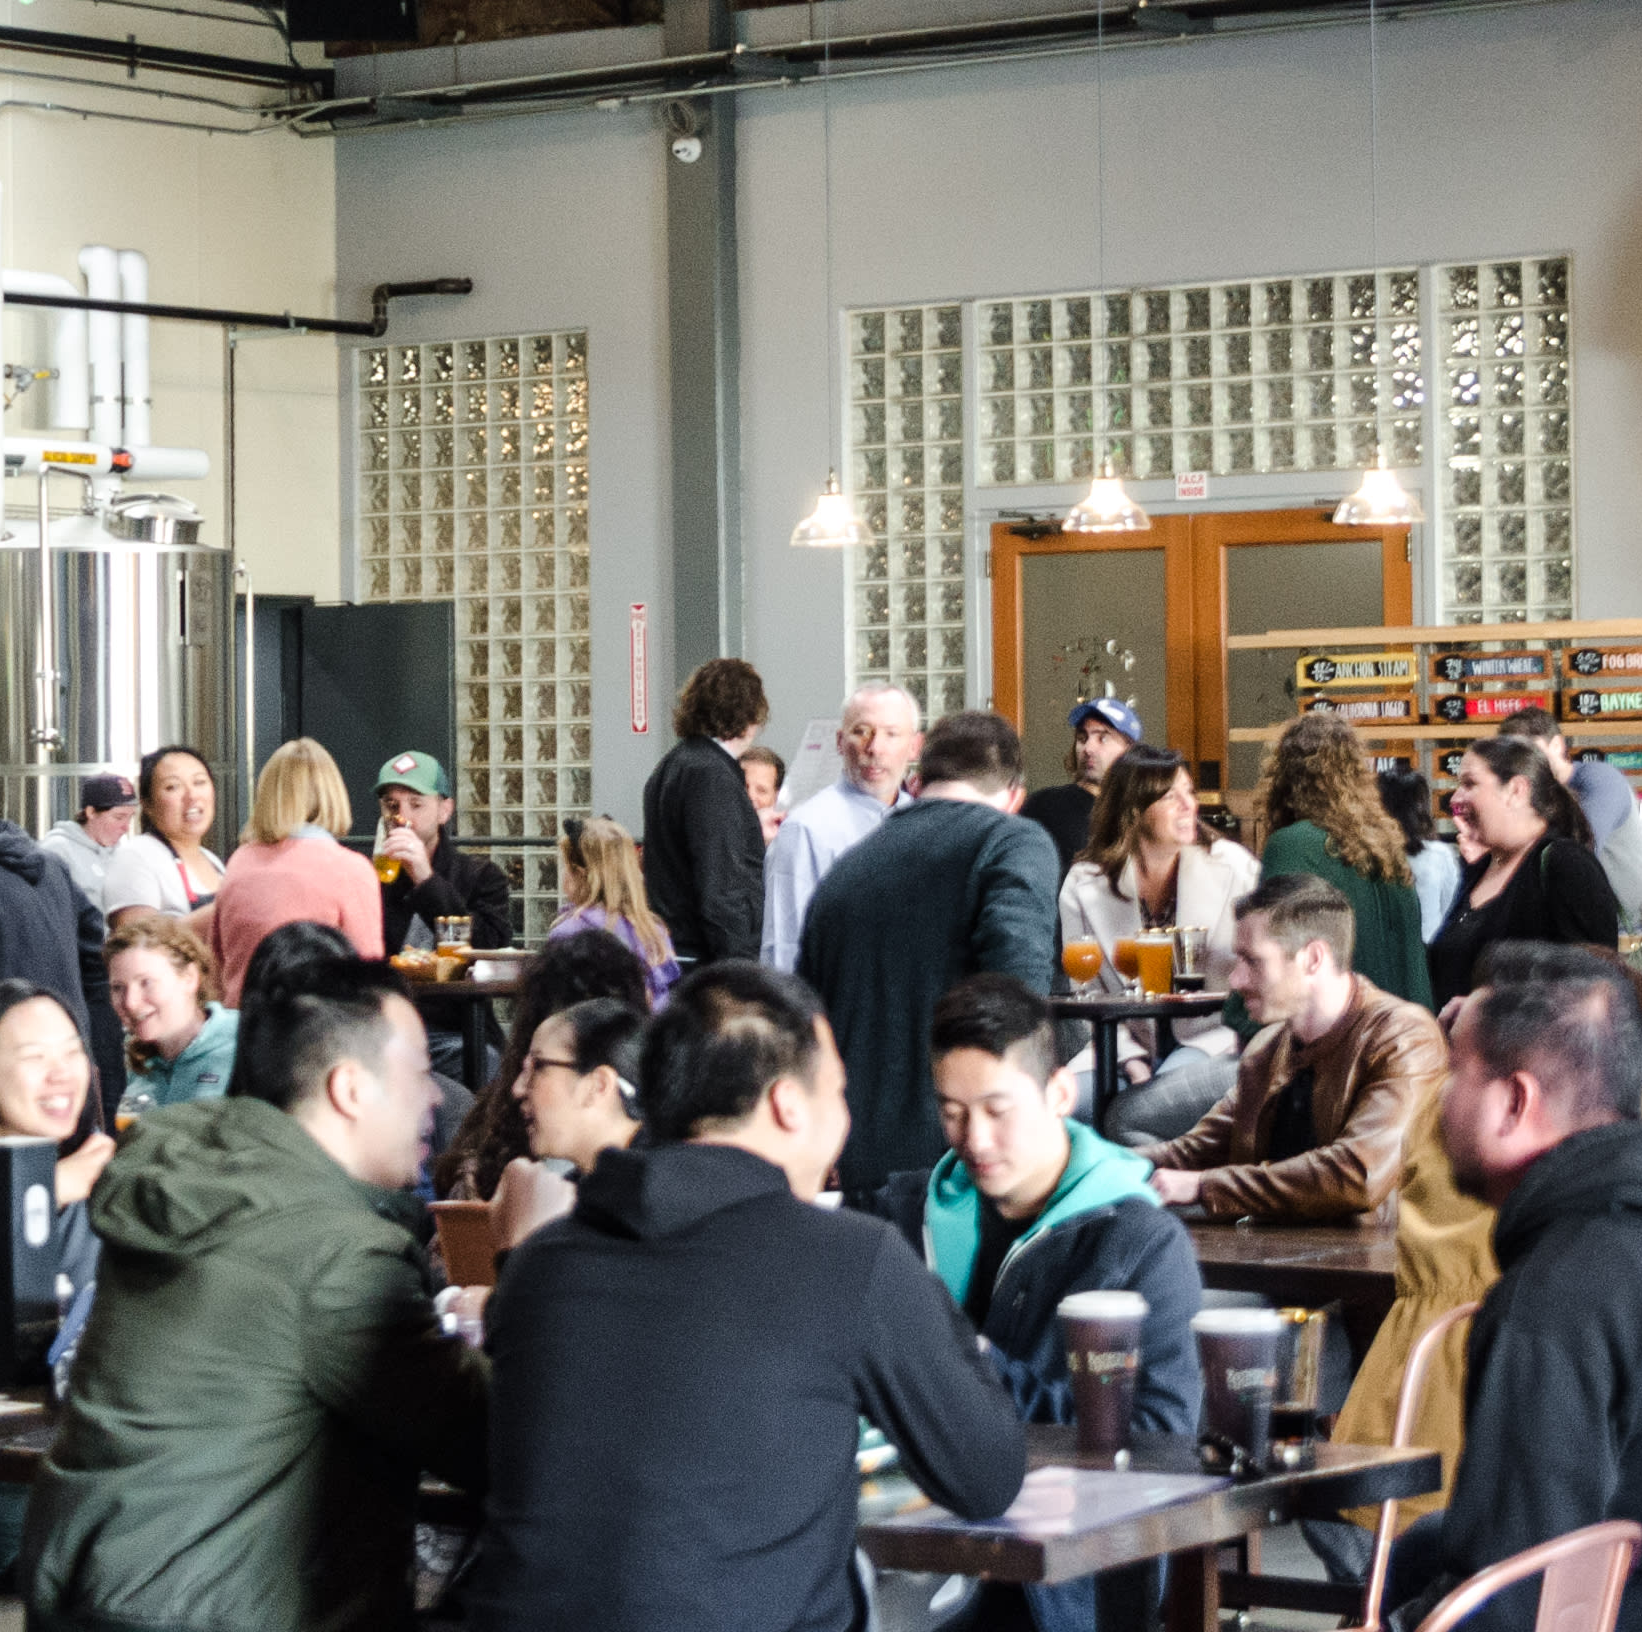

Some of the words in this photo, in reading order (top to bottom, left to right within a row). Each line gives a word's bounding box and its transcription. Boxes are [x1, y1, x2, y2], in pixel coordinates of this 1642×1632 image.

[1378, 660, 1408, 676] STEAM
[1601, 655, 1624, 669] FOG
[1477, 700, 1492, 714] EL
